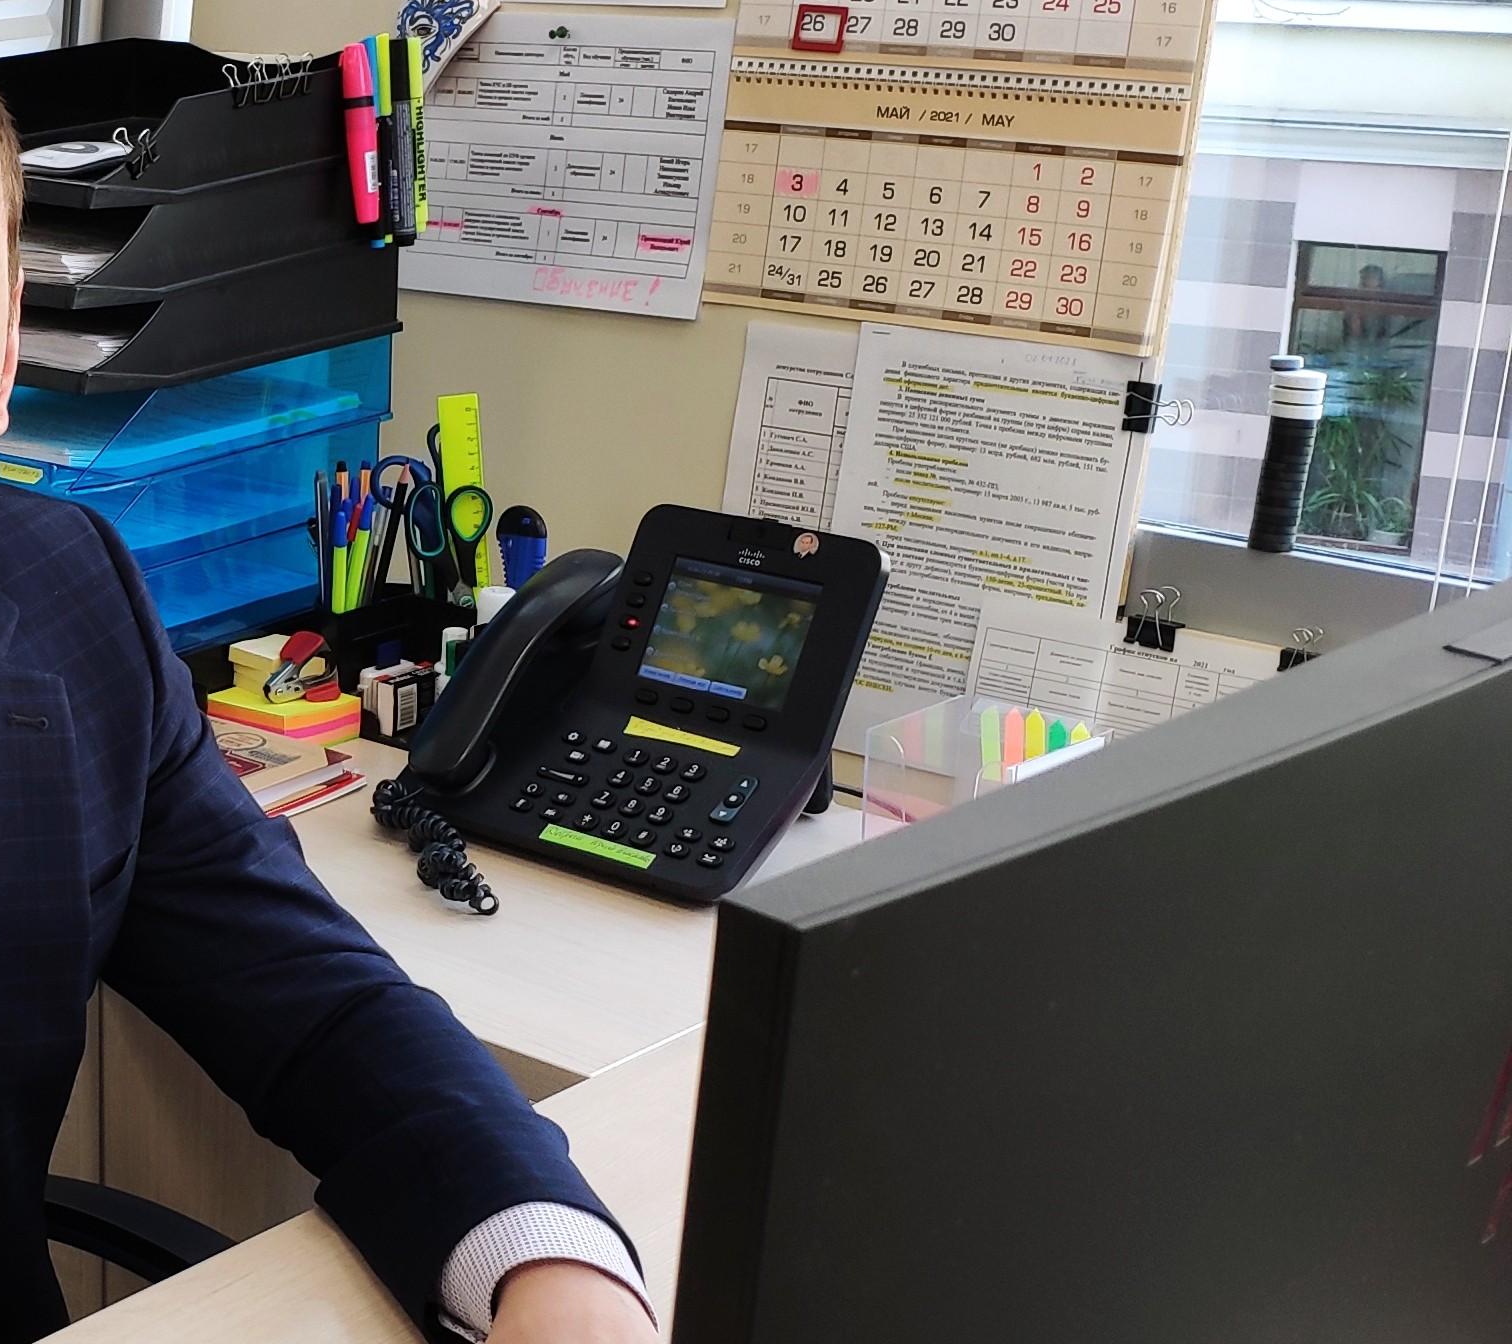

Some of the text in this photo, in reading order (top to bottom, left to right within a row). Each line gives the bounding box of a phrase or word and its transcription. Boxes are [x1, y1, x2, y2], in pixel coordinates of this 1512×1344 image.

[800, 13, 1016, 42] 26 27 28 29 30
[876, 104, 1016, 128] МАЙ 2021 MAY
[415, 105, 427, 202] HIGHLIGHTER
[1032, 163, 1095, 186] 1 2
[790, 173, 1091, 219] 3 4 5 6 7 8 9
[783, 204, 1093, 252] 10 11 12 13 14 15 16
[779, 234, 1088, 285] 17 18 19 20 21 22 23
[767, 264, 1084, 317] 24/31 25 26 27 28 29 30
[738, 556, 761, 567] CISCO
[1193, 660, 1208, 669] 2021
